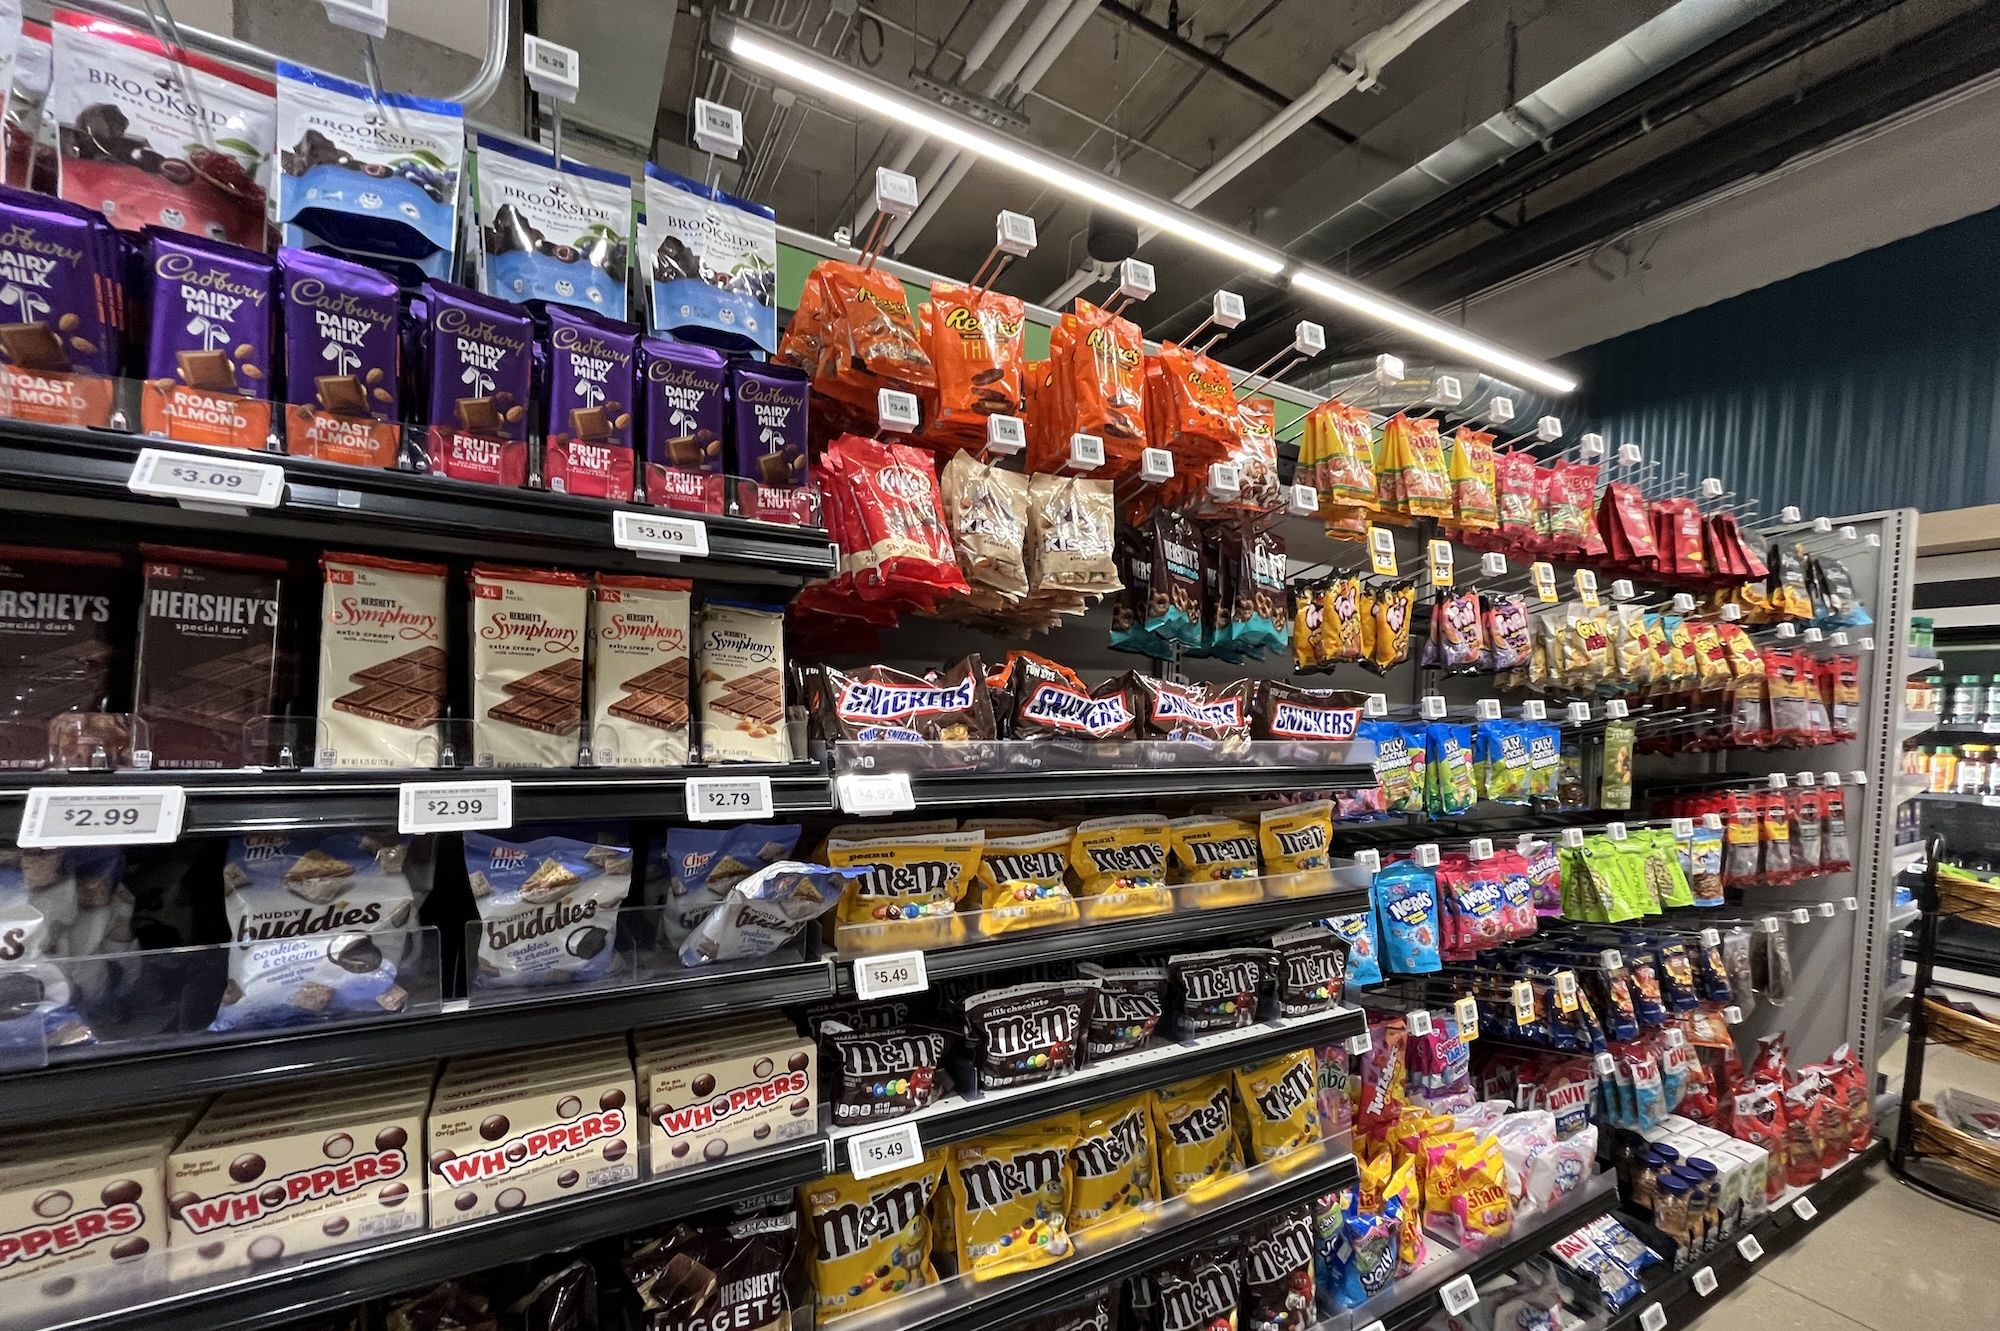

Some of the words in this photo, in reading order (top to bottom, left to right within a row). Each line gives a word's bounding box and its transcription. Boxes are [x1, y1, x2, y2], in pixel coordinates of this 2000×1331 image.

[308, 116, 437, 149] BROOKSIDE
[504, 186, 610, 221] BROOKSIDE
[668, 215, 759, 249] BROOKSIDE
[156, 253, 266, 306] Cadbury
[181, 284, 243, 312] DAIRY
[291, 279, 393, 330] Cadbury
[186, 299, 236, 322] MILK
[315, 310, 371, 335] DAIRY
[436, 309, 525, 355] Cadbury
[320, 325, 365, 348] MILK
[552, 327, 630, 366] Cadbury
[457, 337, 506, 360] DAIRY
[460, 352, 499, 372] MILK
[571, 353, 614, 374] DAIRY
[573, 365, 608, 384] MILK
[648, 360, 721, 395] Cadbury
[174, 391, 238, 414] ROAST
[665, 385, 705, 403] DAIRY
[668, 396, 699, 412] MILK
[738, 380, 804, 412] Cadbury
[162, 403, 247, 428] ALMOND
[755, 404, 790, 419] DAIRY
[891, 402, 908, 412] $3.49
[315, 416, 372, 436] ROAST
[758, 414, 786, 428] MILK
[305, 428, 380, 450] ALMOND
[453, 434, 500, 454] FRUIT
[452, 447, 464, 459] &
[465, 449, 500, 466] NUT
[568, 442, 611, 459] FRUIT
[568, 454, 579, 466] &
[580, 457, 611, 470] NUT
[172, 467, 242, 487] $3.09
[665, 471, 704, 484] FRUIT
[665, 482, 675, 493] &
[675, 484, 704, 496] NUT
[758, 487, 792, 499] FRUIT
[757, 497, 766, 508] &
[767, 498, 791, 509] NUT
[638, 527, 683, 542] $3.09
[1164, 539, 1199, 571] HERSHEY'S
[153, 567, 172, 576] XL
[332, 572, 348, 582] XL
[482, 587, 496, 597] XL
[603, 592, 616, 600] XL
[0, 590, 109, 622] RSHEY'S
[150, 589, 278, 626] HERSHEY'S
[361, 597, 396, 608] HERSHEY'S
[334, 597, 439, 640] Symphony
[510, 611, 541, 622] HERSHEY'S
[626, 613, 653, 623] HERSHEY'S
[46, 622, 75, 632] dark
[176, 623, 219, 635] special
[223, 624, 249, 635] dark
[363, 632, 395, 640] creamy
[480, 612, 580, 653] Symphony
[602, 614, 687, 652] Symphony
[703, 630, 776, 663] Symphony
[1025, 664, 1040, 676] FUN
[1041, 669, 1056, 682] SIZE
[846, 681, 973, 716] SNICKERS
[1276, 705, 1353, 735] SNICKERS
[1380, 738, 1405, 755] JOLLY
[1531, 737, 1552, 753] JOLLY
[428, 800, 482, 815] $2.99
[709, 793, 750, 806] $2.79
[64, 808, 139, 826] $2.99
[1269, 822, 1293, 831] peanut
[1082, 836, 1115, 847] peanut
[1182, 831, 1211, 841] peanut
[683, 851, 716, 868] Chex
[849, 851, 895, 862] peanut
[1087, 842, 1164, 872] m&m's
[1527, 856, 1560, 876] Skittles
[854, 861, 960, 897] m&m's
[253, 909, 301, 921] MUDDY
[487, 899, 597, 950] buddies
[237, 902, 382, 950] buddies
[253, 942, 308, 961] cookies
[262, 960, 270, 968] &
[274, 948, 320, 967] cream
[507, 941, 550, 957] cookies
[875, 968, 908, 983] $5.49
[1289, 951, 1345, 988] m&m's
[1182, 962, 1259, 1002] m&m's
[983, 1008, 1002, 1019] milk
[1002, 1000, 1049, 1015] chocolate
[986, 1005, 1079, 1058] m&m's
[835, 1034, 944, 1076] m&m's
[656, 1083, 687, 1093] Original
[664, 1073, 805, 1132] WHOPPERS
[435, 1125, 473, 1137] Original
[445, 1113, 621, 1182] WHOPPERS
[869, 1142, 903, 1160] $5.49
[175, 1165, 221, 1178] Original
[183, 1162, 198, 1171] Be
[500, 1170, 531, 1184] Original
[559, 1153, 575, 1163] Milk
[576, 1148, 594, 1157] Balls
[960, 1148, 1067, 1212] m&m'
[187, 1153, 402, 1228] WHOPPERS
[737, 1217, 788, 1234] SHARE
[814, 1177, 934, 1262] m&m's
[0, 1207, 137, 1261] PPERS
